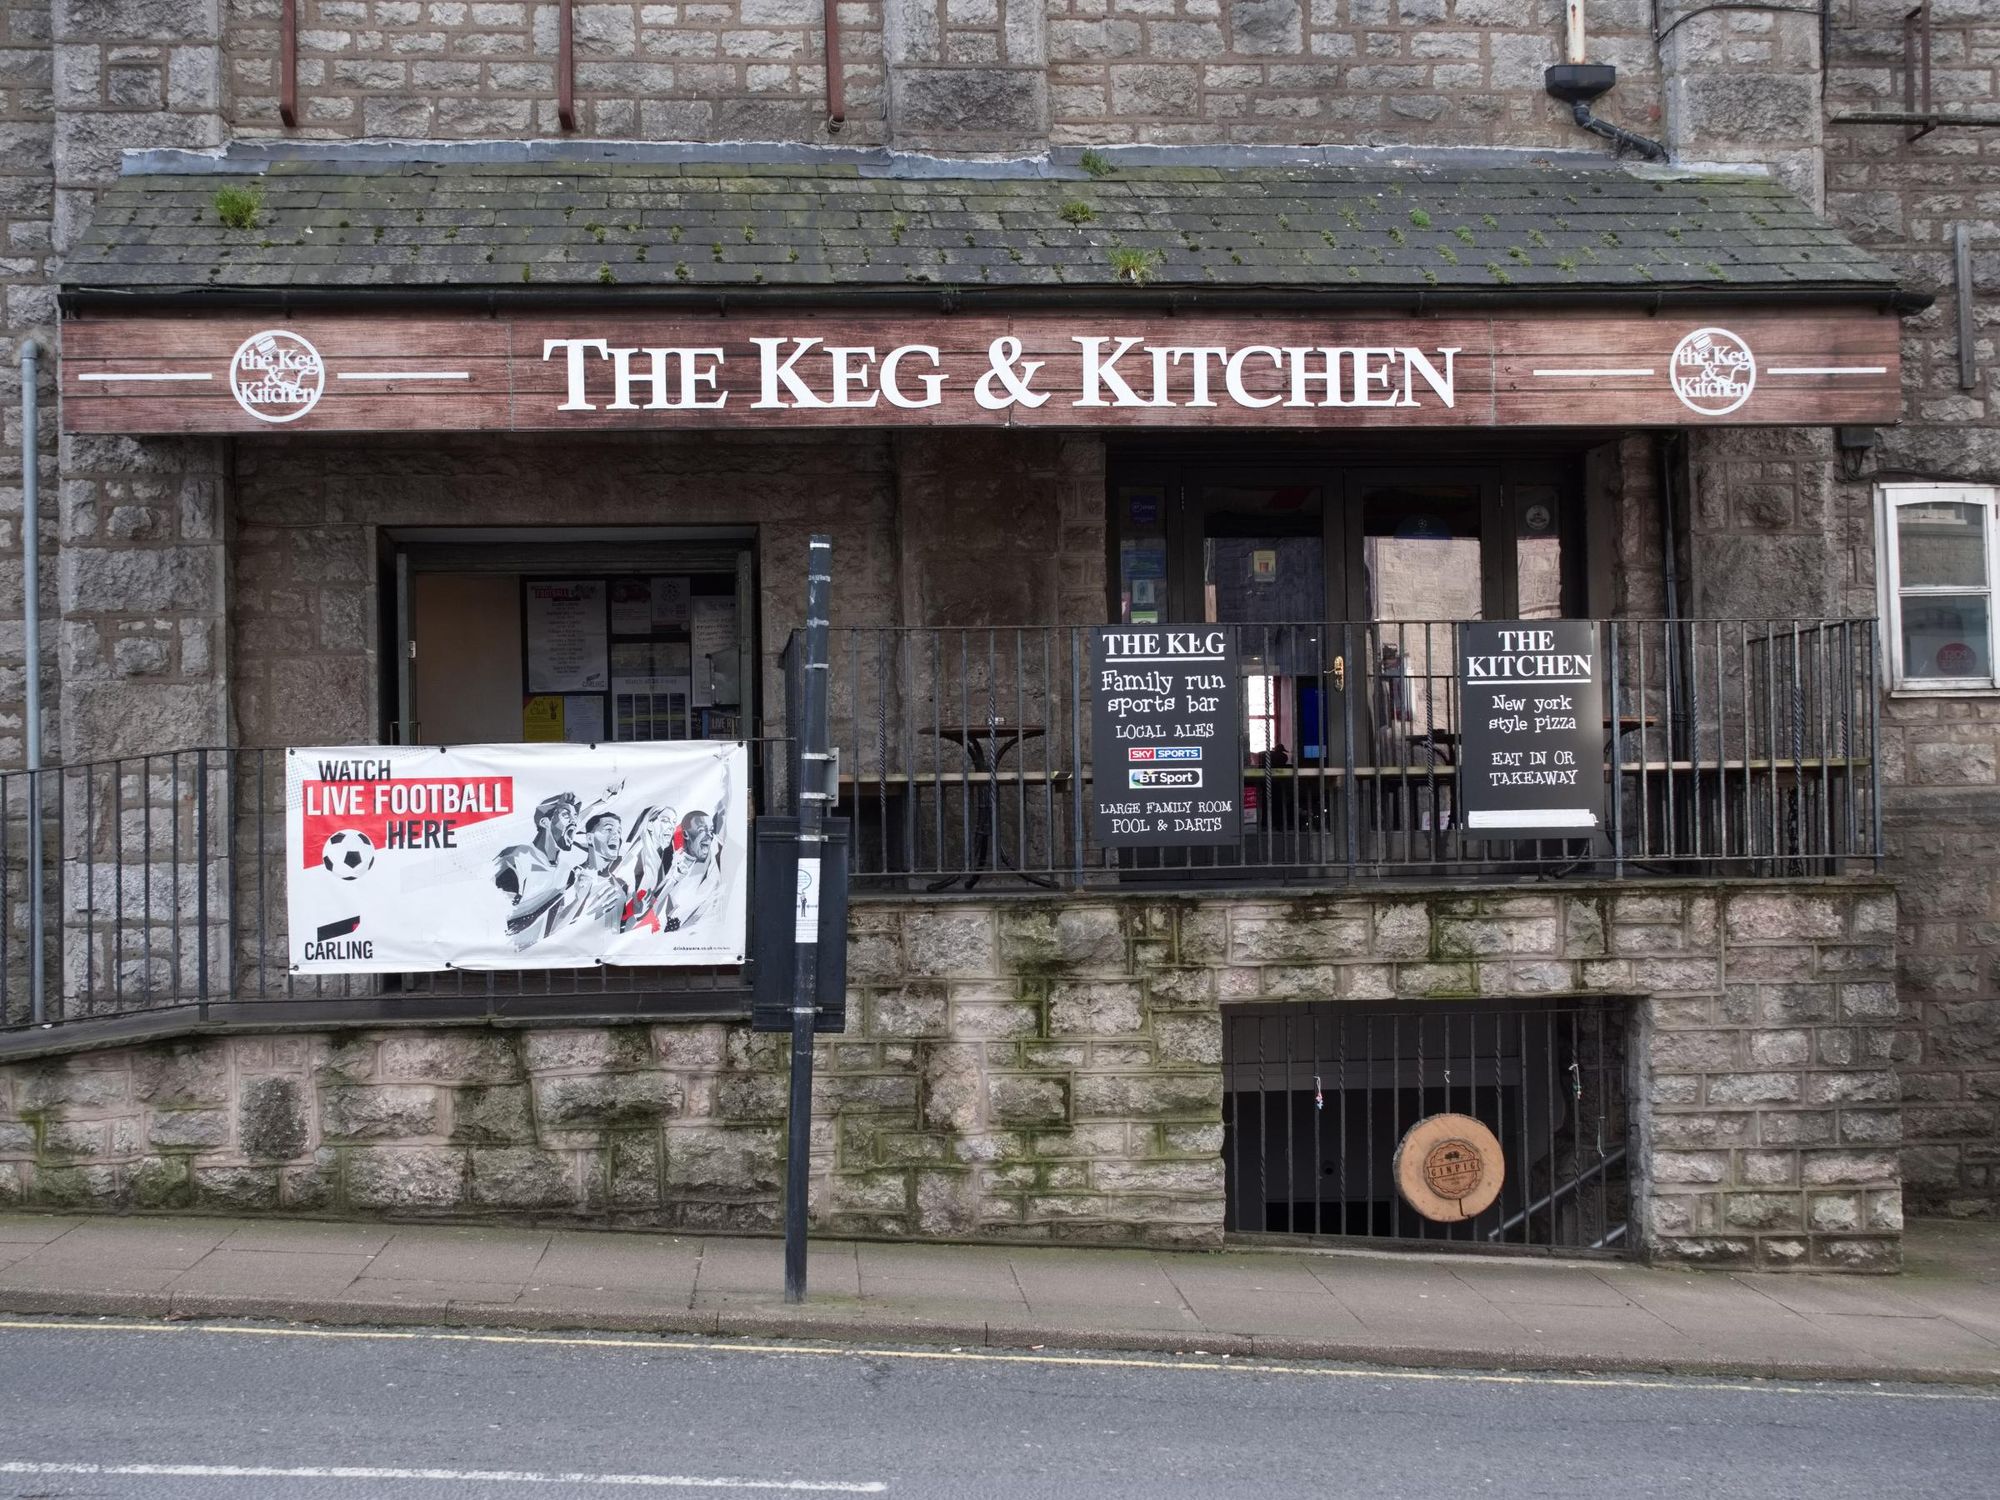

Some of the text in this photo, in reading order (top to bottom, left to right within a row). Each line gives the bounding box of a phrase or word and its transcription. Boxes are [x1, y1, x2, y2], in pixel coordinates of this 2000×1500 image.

[240, 349, 318, 375] the Keg
[1680, 345, 1750, 370] the Keg
[264, 365, 284, 386] &
[543, 336, 1462, 411] THE KEG & KITCHEN
[1701, 361, 1719, 381] &
[239, 381, 315, 403] Kitchen
[1678, 376, 1747, 398] Kitchen
[1102, 632, 1226, 655] THE KEG
[1498, 630, 1555, 652] THE
[1467, 654, 1592, 677] KITCHEN
[1101, 669, 1226, 695] Family run
[1108, 695, 1219, 717] sports bar
[1492, 694, 1572, 713] New york
[1115, 723, 1215, 739] LOCAL ALES
[1489, 715, 1577, 733] style pizza
[1131, 749, 1199, 758] SKY SPORTS
[1491, 750, 1575, 766] EAT IN OR
[318, 759, 391, 783] WATCH
[1139, 772, 1193, 785] BT Sport
[1489, 769, 1578, 786] TAKEAWAY
[306, 782, 509, 816] LIVE FOOTBALL
[1100, 801, 1232, 814] LARGE FAMILY ROOM
[387, 819, 457, 850] HERE
[1112, 817, 1222, 834] POOL & DARTS
[304, 940, 373, 960] CARLING
